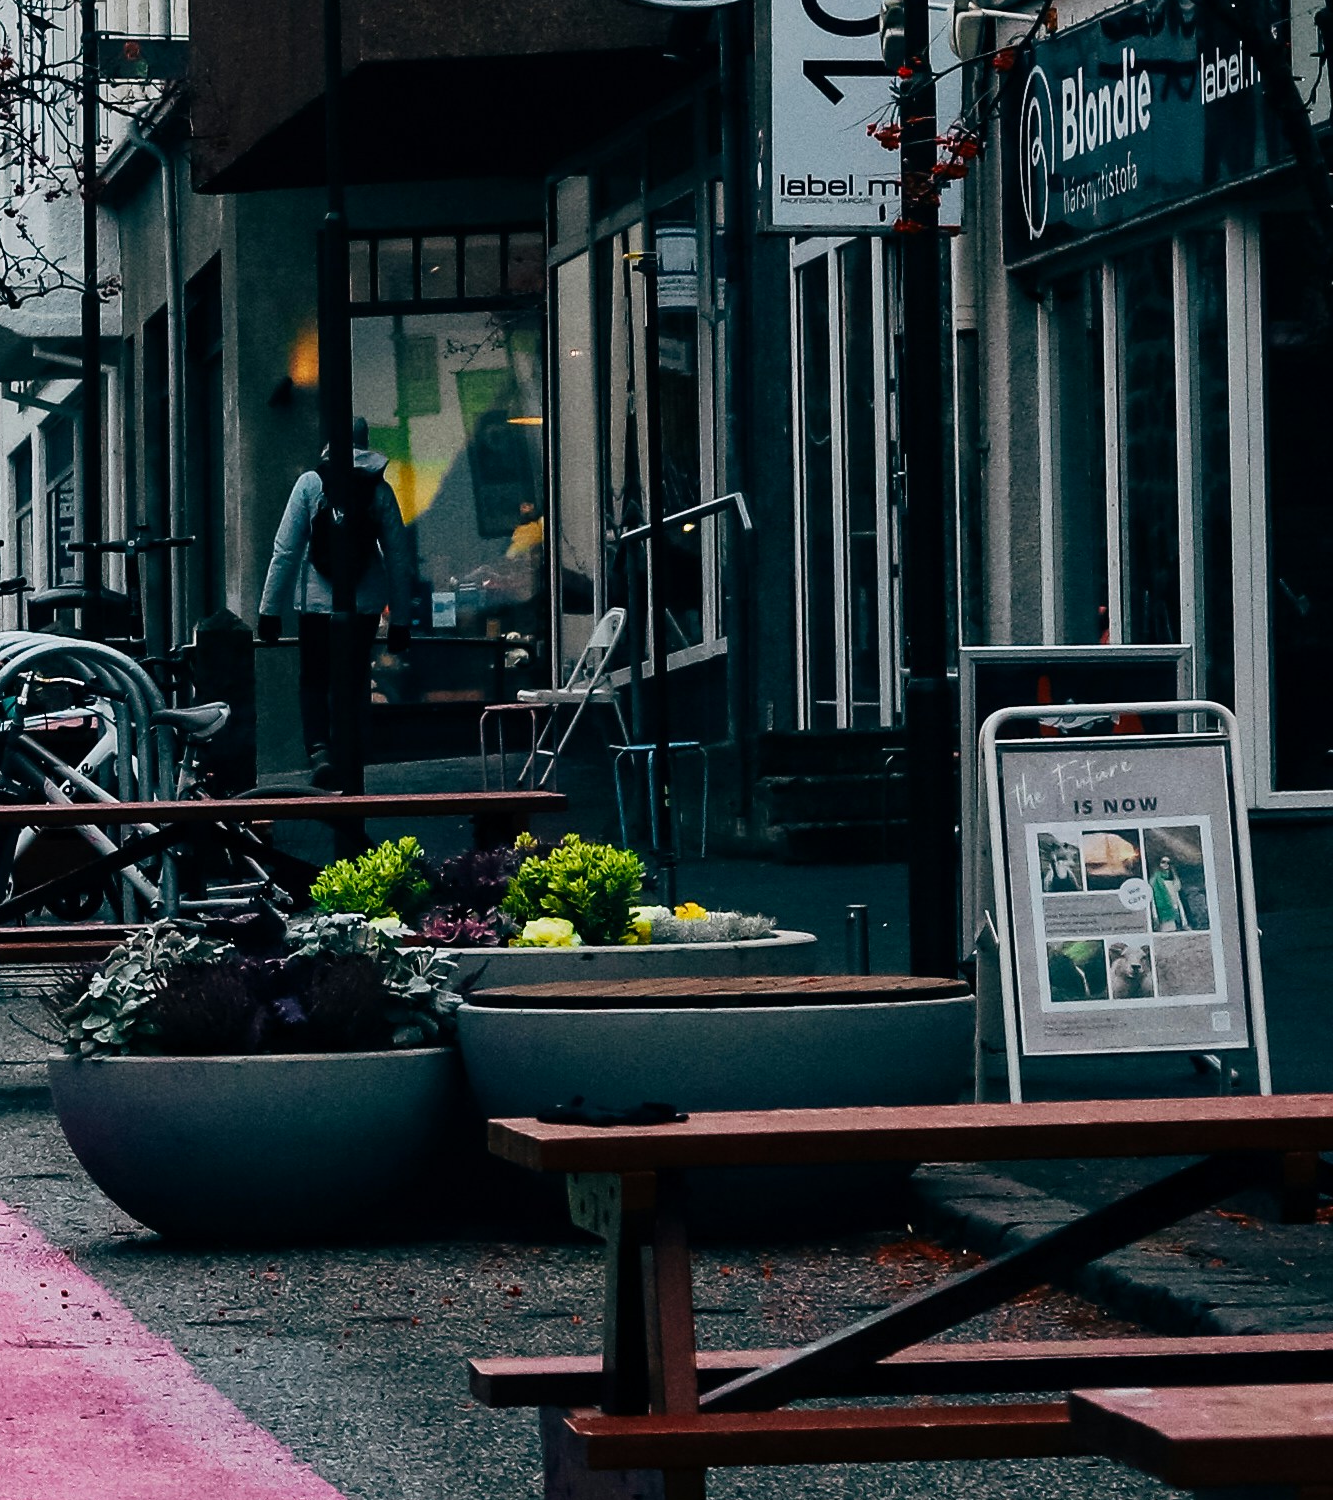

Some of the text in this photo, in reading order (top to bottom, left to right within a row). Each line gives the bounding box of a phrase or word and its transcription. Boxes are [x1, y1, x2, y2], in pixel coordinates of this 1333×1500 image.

[1062, 47, 1151, 161] Blondie
[780, 174, 900, 196] label.m
[1062, 151, 1137, 215] hársnyrtistofa
[1074, 797, 1158, 815] IS NOW
